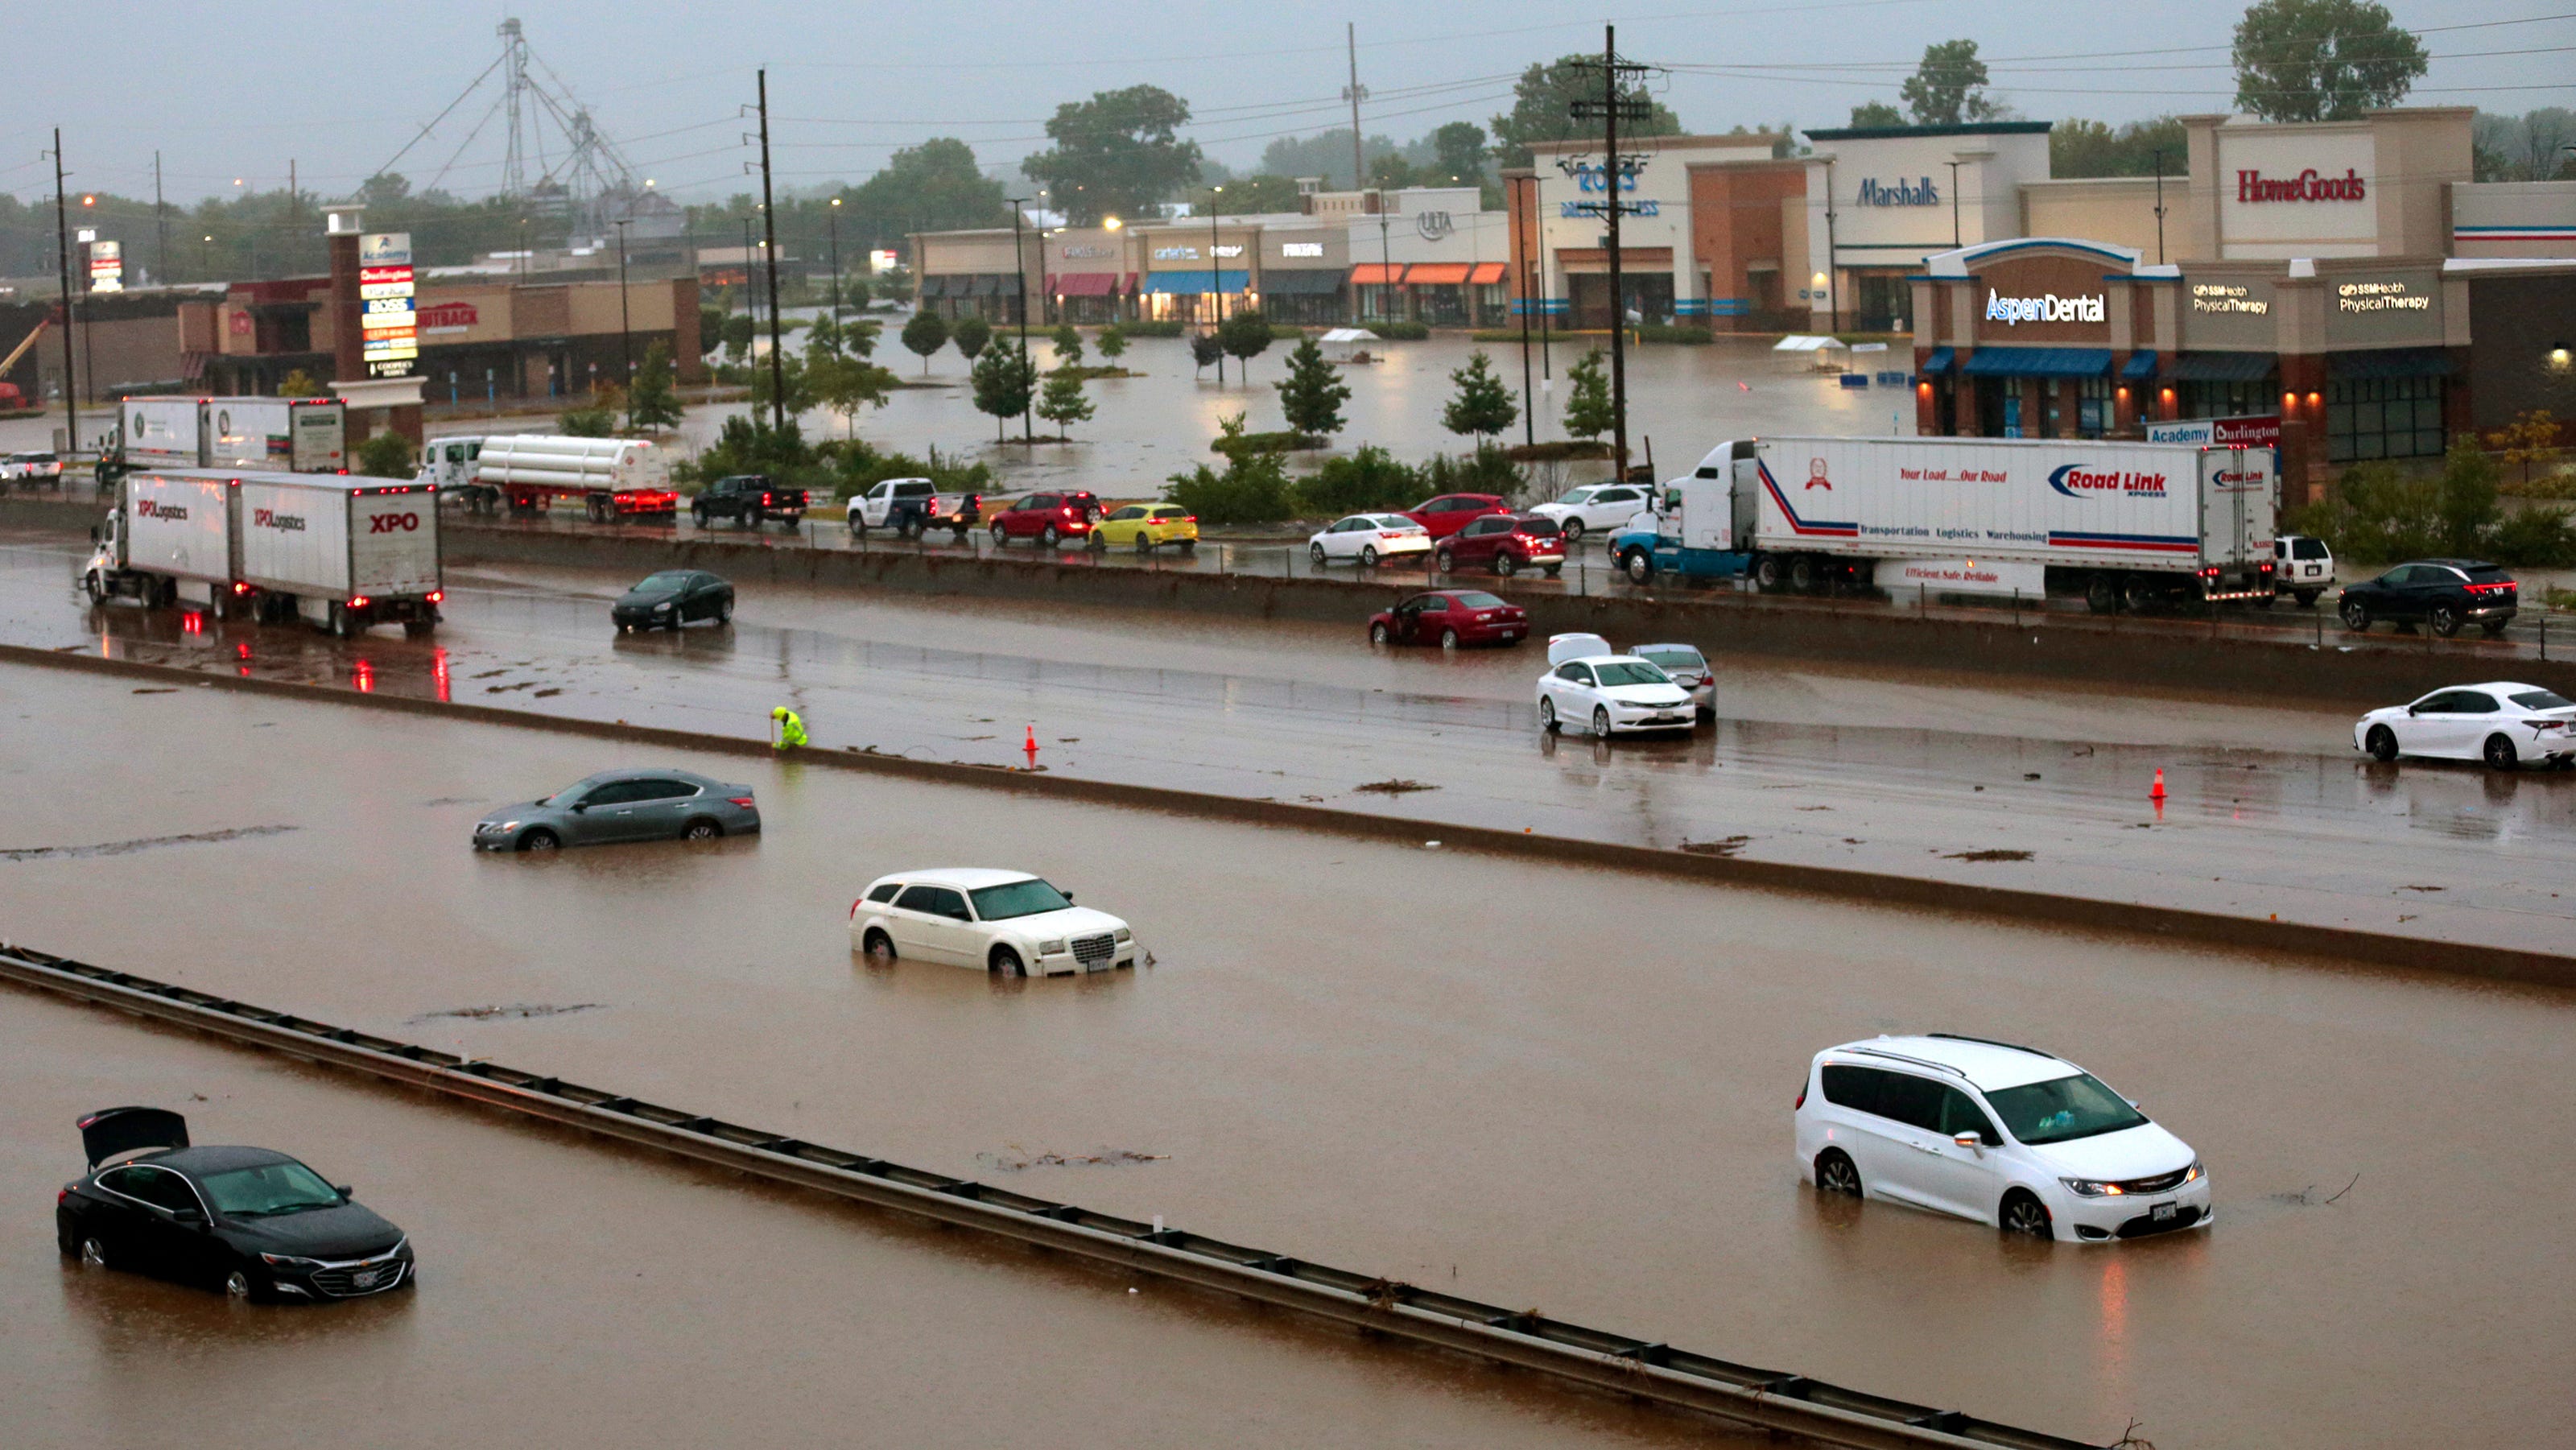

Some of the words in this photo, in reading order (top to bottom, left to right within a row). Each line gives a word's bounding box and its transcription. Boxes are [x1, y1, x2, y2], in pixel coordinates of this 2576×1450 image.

[1579, 165, 1635, 192] ROS
[2236, 167, 2365, 202] HomeGoods
[1856, 177, 1938, 206] Marshalls
[1418, 210, 1455, 237] ULTA
[361, 269, 412, 282] Burlington
[369, 298, 408, 313] ROSS
[1986, 287, 2105, 325] AspenDental
[416, 309, 479, 328] OUTBACK
[2152, 428, 2210, 444] Academy
[2215, 423, 2280, 442] Burlington
[1901, 467, 1921, 481] Your
[1981, 469, 2007, 483] Road
[2067, 470, 2120, 490] Road
[2123, 472, 2166, 492] Link
[2245, 470, 2263, 481] Link
[2127, 490, 2167, 498] XPRESS
[369, 512, 419, 534] XPO
[1860, 524, 1930, 537] Transportation
[1936, 527, 1979, 539] Logistics
[1986, 530, 2047, 544] Warehousing
[1963, 571, 1998, 582] Reliable
